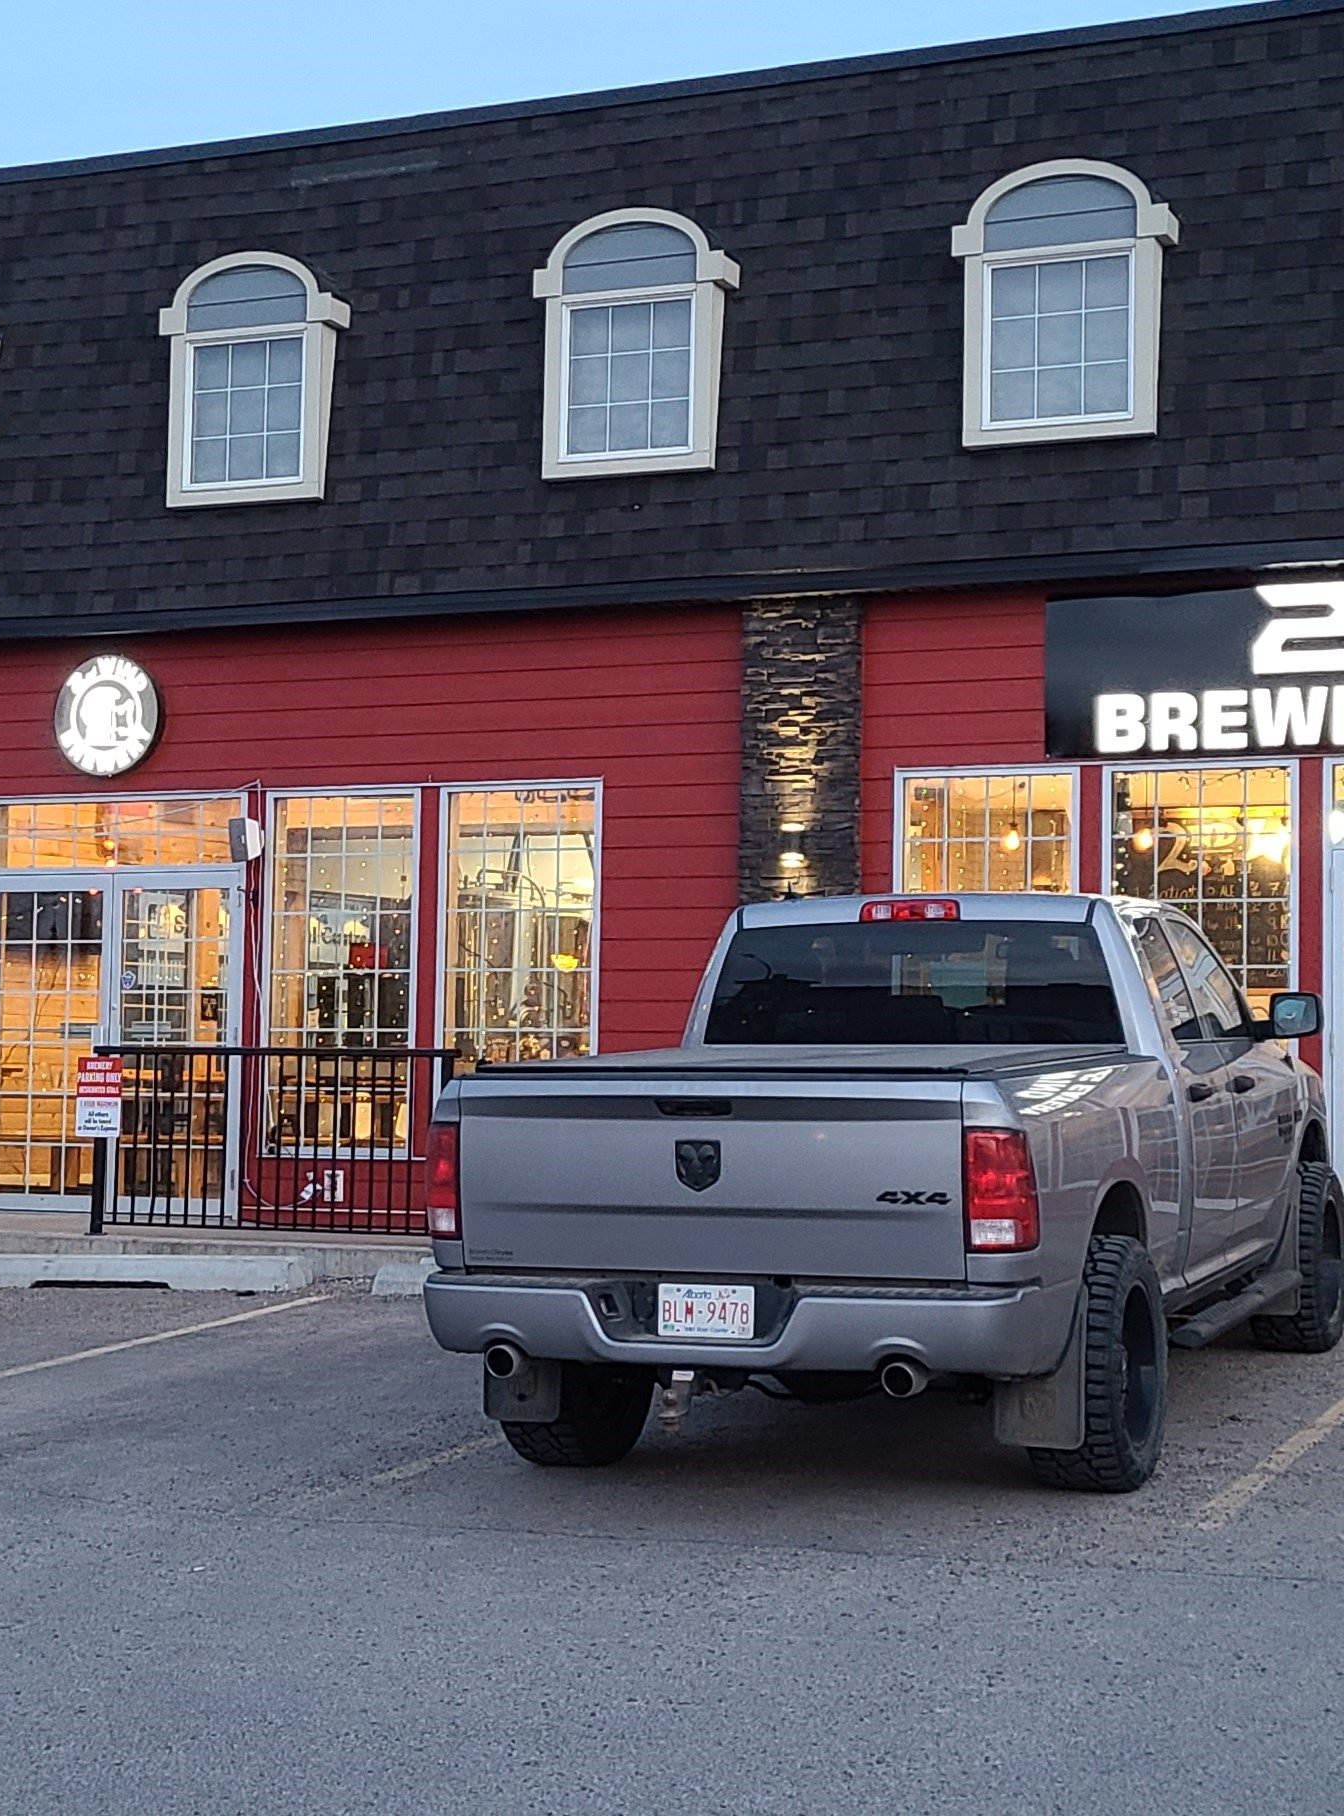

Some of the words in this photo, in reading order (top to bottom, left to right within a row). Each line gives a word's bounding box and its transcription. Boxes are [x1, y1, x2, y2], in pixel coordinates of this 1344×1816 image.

[86, 1061, 113, 1070] BREWERY
[77, 1072, 105, 1083] PARKING
[105, 1072, 122, 1083] ONLY
[682, 1289, 712, 1299] Alberta
